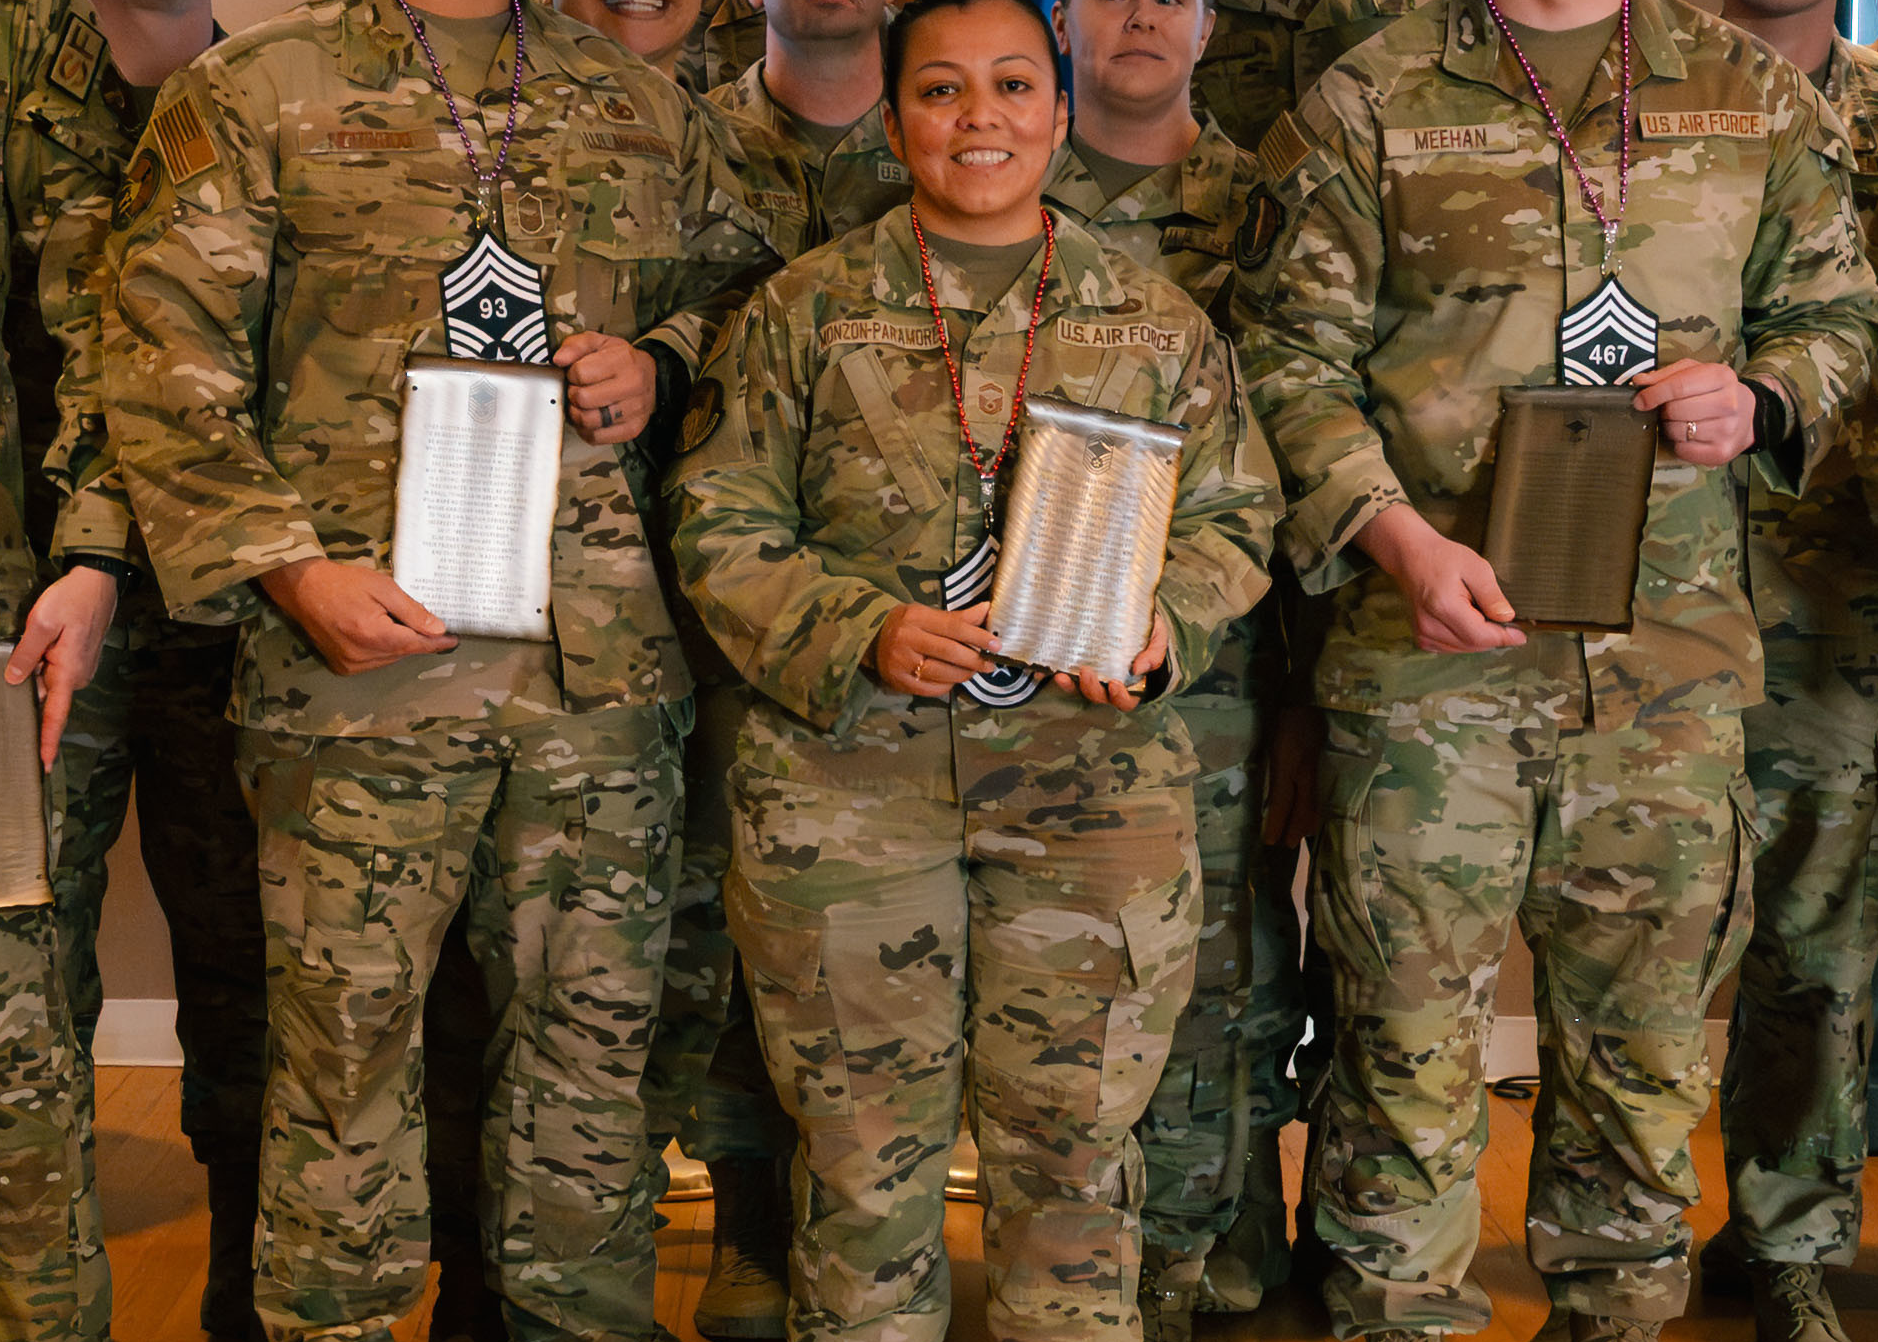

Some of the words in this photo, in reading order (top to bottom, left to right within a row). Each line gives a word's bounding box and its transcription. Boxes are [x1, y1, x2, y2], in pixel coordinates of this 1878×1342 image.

[1678, 114, 1706, 133] AIR
[1708, 112, 1761, 135] FORCE
[1413, 127, 1488, 151] MEEHAN
[479, 297, 508, 320] 93
[1061, 320, 1089, 345] U.S.
[1092, 326, 1123, 345] AIR
[1128, 323, 1180, 352] FORCE
[1588, 343, 1629, 366] 467
